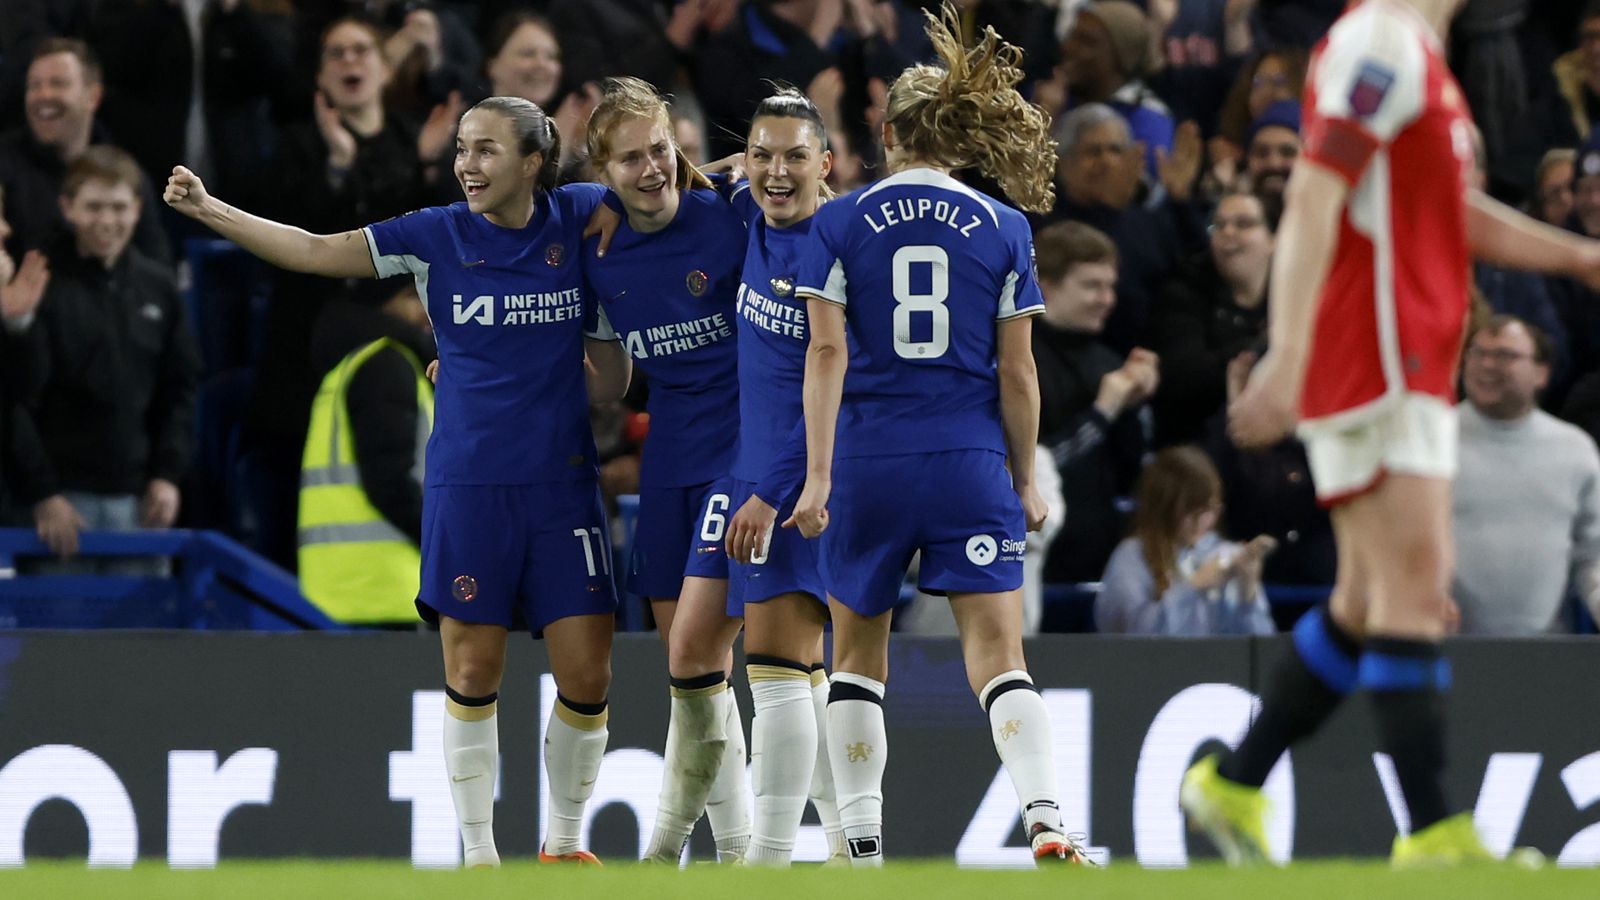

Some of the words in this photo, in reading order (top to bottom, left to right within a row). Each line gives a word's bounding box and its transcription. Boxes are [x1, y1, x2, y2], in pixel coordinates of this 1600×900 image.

[864, 198, 982, 238] LEUPOLZ
[502, 303, 582, 326] ATHLETE
[504, 287, 581, 309] INFINITE
[746, 288, 805, 324] INFINITE
[892, 245, 950, 359] 8
[646, 312, 726, 342] INFINITE
[743, 305, 805, 340] ATHLETE
[653, 326, 732, 357] ATHLETE
[700, 493, 730, 542] 6
[573, 526, 609, 577] 11
[955, 683, 1295, 868] 40
